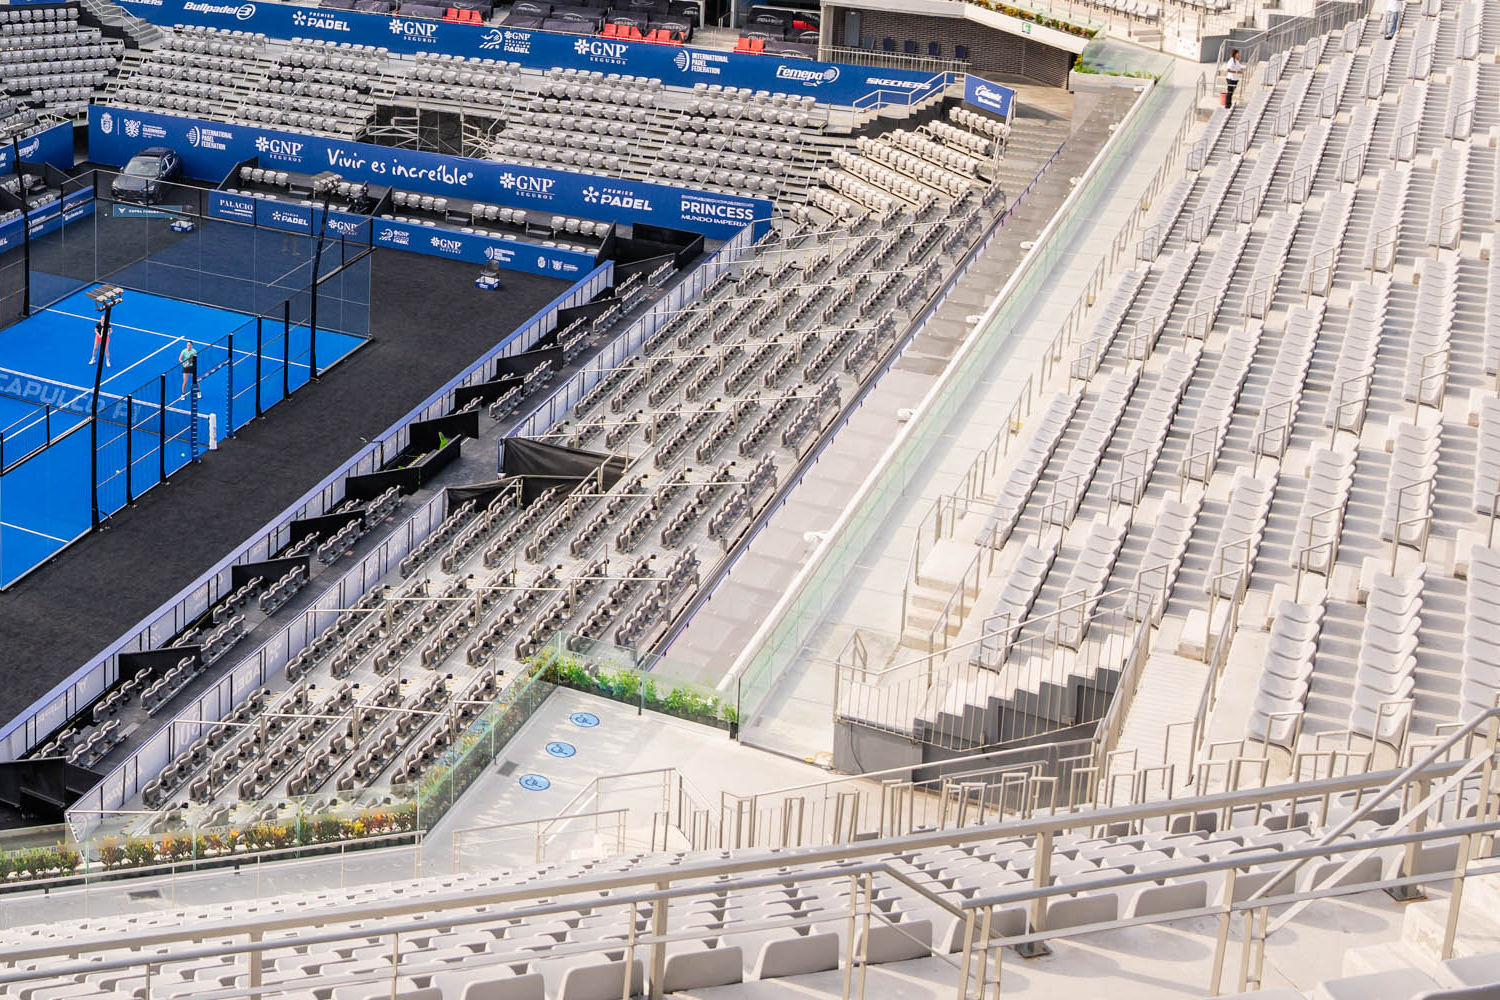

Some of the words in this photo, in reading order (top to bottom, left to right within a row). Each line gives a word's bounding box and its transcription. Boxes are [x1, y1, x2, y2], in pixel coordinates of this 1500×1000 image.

[183, 1, 238, 16] Bullpadel
[307, 17, 350, 32] PADEL
[403, 21, 436, 37] GNP
[403, 35, 437, 44] SEGUROS
[512, 32, 530, 40] GNP
[504, 46, 529, 54] PADEL
[590, 42, 626, 57] GNP
[590, 57, 627, 65] SEGUROS
[691, 52, 728, 63] INTERNATIONAL
[691, 59, 706, 67] PADEL
[691, 65, 721, 74] FEDERATION
[776, 65, 824, 82] Femepa
[865, 77, 932, 90] SKECHERS
[270, 139, 301, 156] GNP
[269, 154, 301, 163] SEGUROS
[327, 148, 365, 171] Vivir
[372, 161, 386, 173] es
[392, 160, 469, 186] increíble
[516, 176, 552, 193] GNP
[516, 191, 553, 200] SEGUROS
[603, 187, 633, 196] PREMIER
[220, 199, 253, 210] PALACIO
[601, 194, 653, 211] PADEL
[681, 201, 753, 220] PRINCESS
[282, 216, 308, 226] PADEL
[681, 215, 712, 223] MUNDO
[337, 221, 357, 230] GNP
[440, 240, 461, 250] GNP
